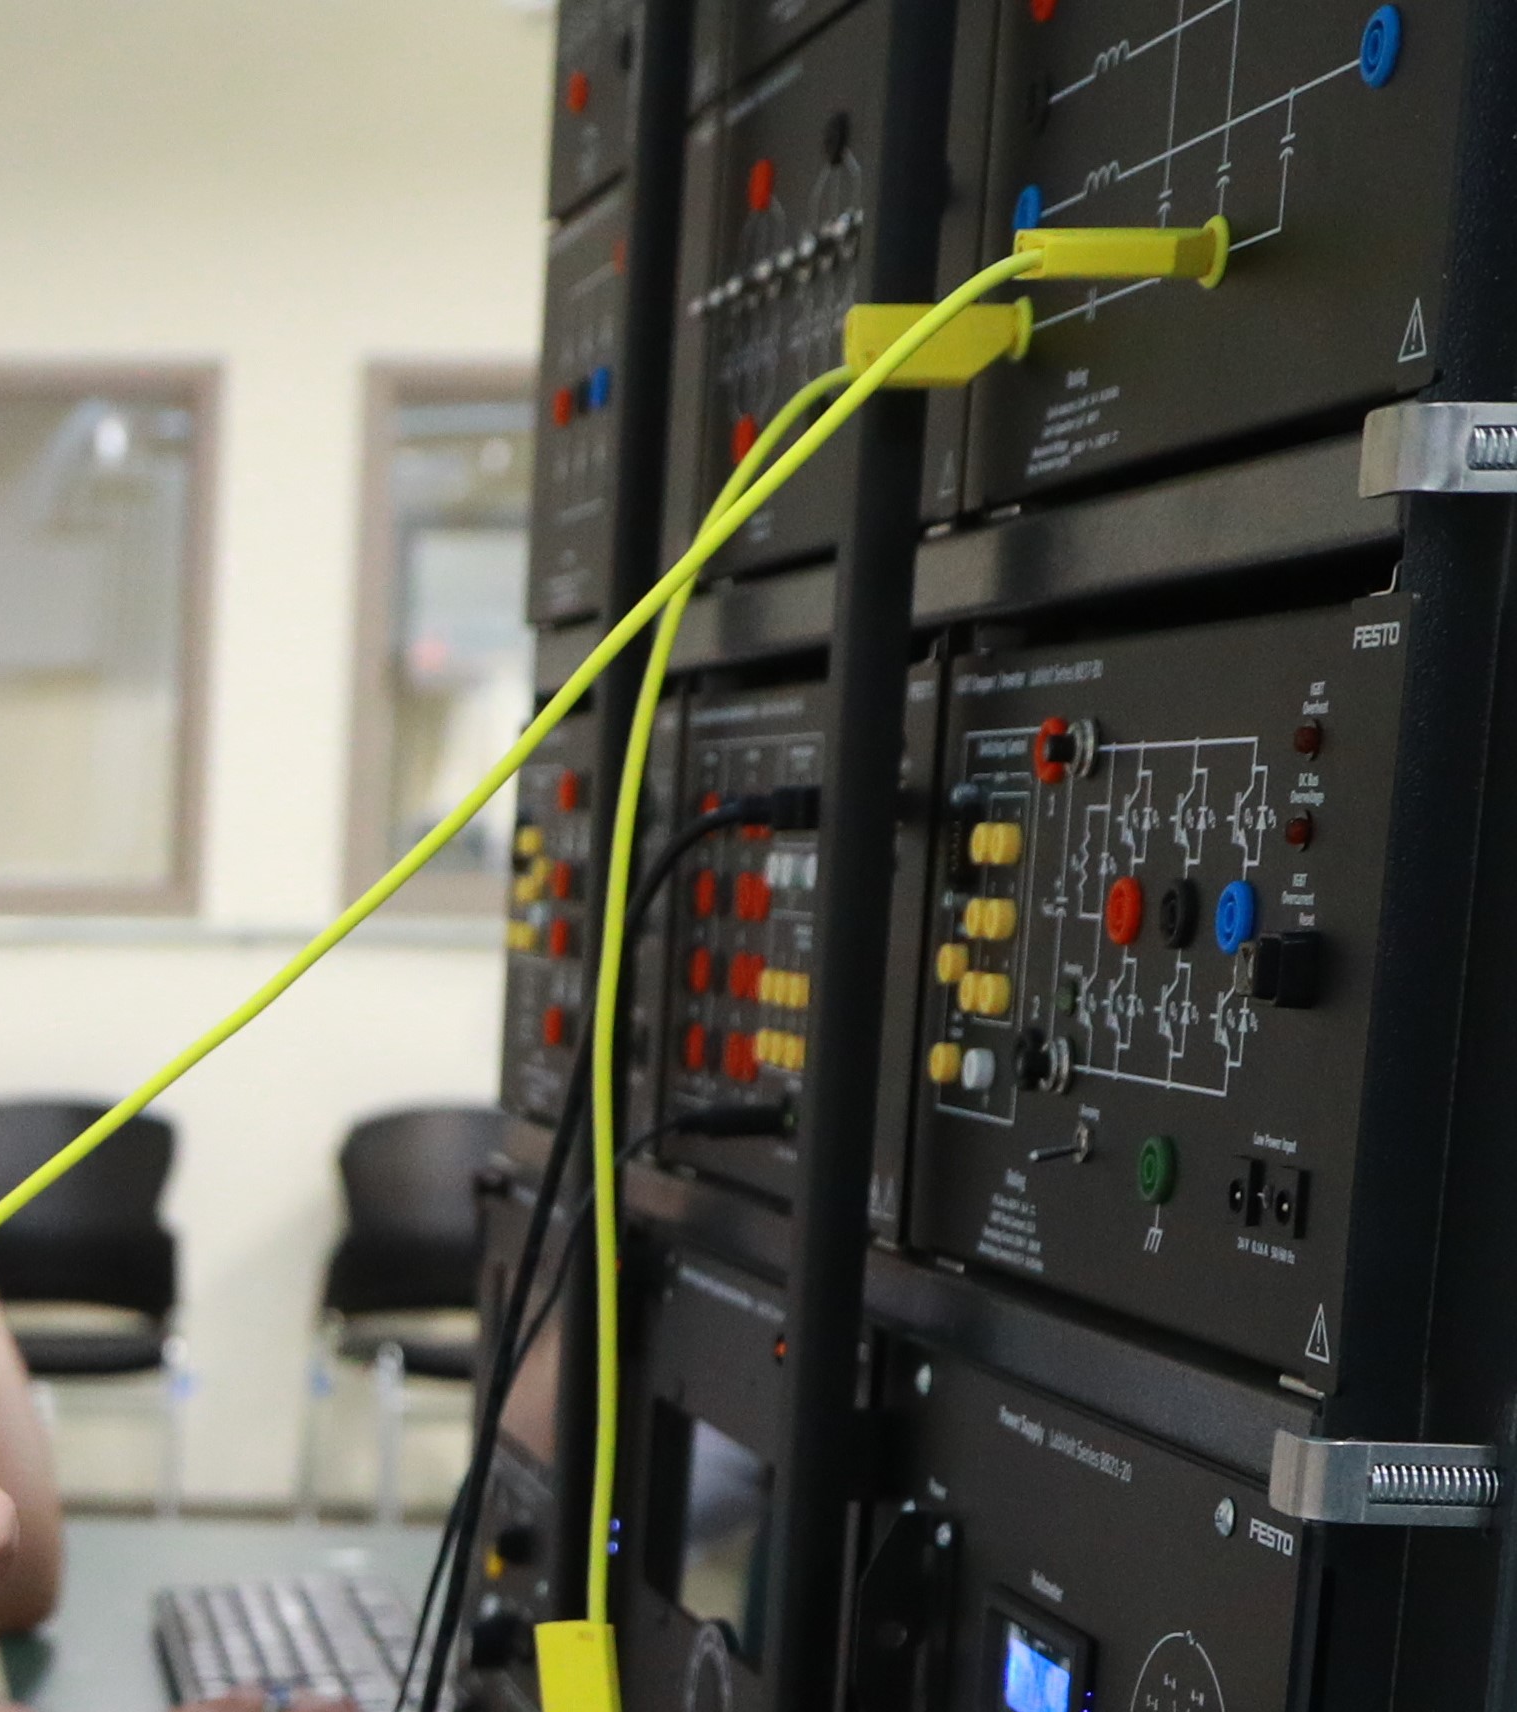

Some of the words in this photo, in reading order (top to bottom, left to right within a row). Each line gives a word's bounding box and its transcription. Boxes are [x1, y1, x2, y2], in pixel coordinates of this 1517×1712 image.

[1352, 621, 1401, 649] FESTO
[999, 1404, 1021, 1431] Power
[1021, 1414, 1045, 1447] Supply
[1077, 1440, 1100, 1468] Series
[1249, 1517, 1294, 1556] FESTO
